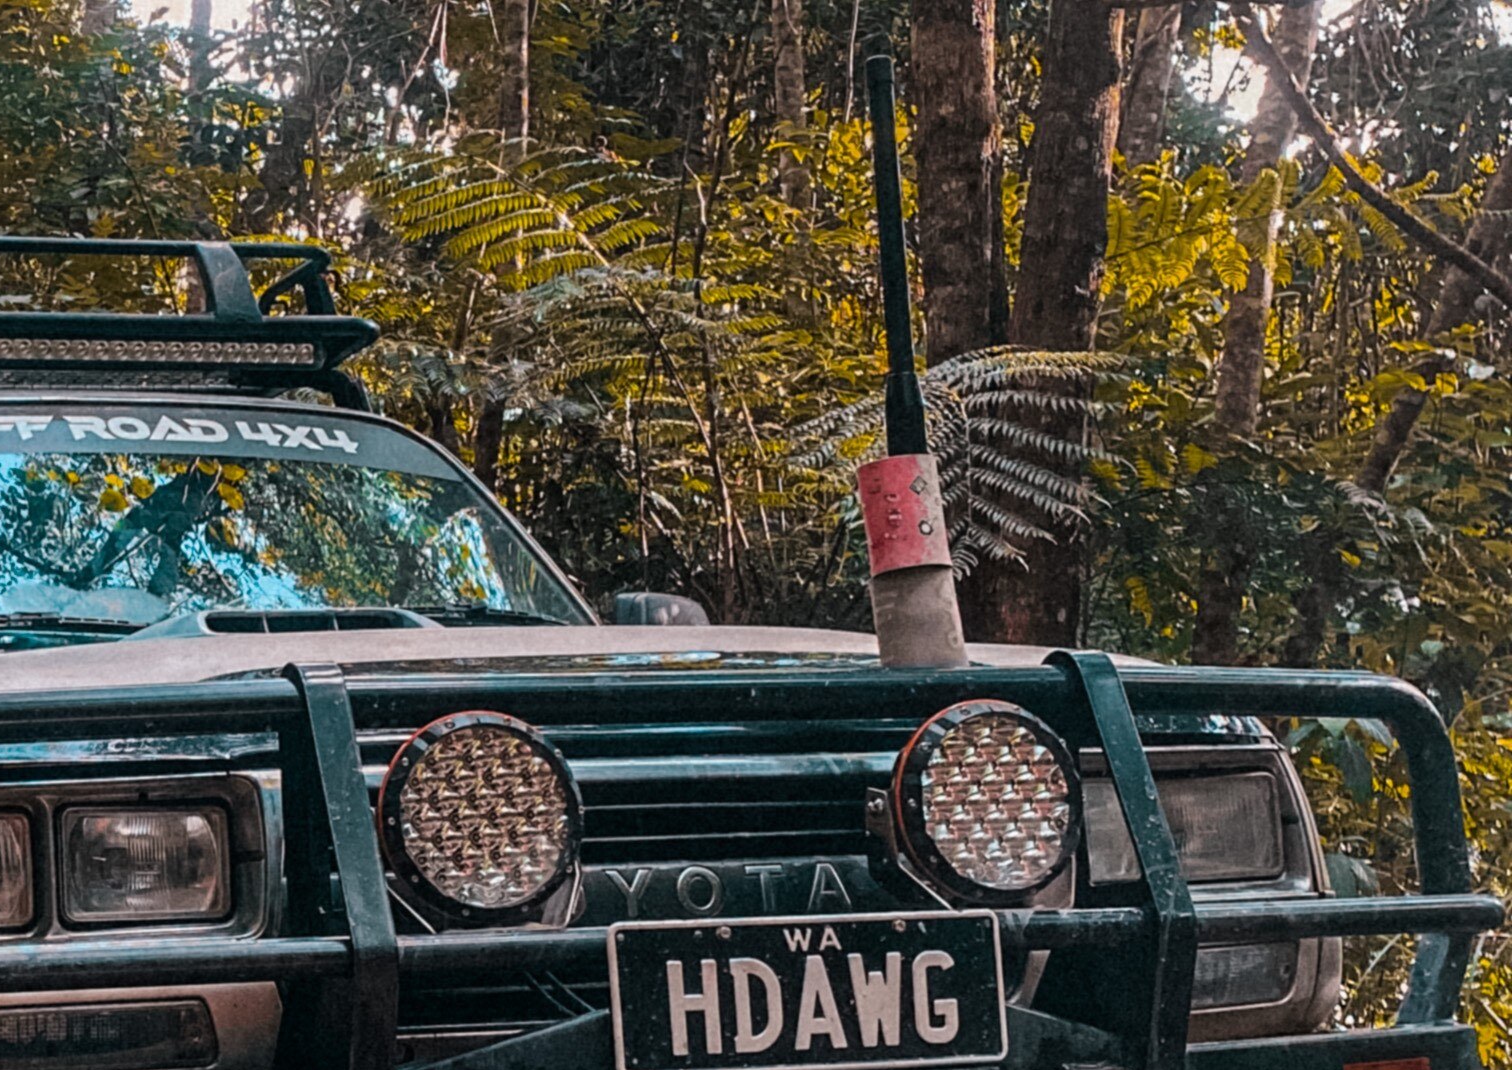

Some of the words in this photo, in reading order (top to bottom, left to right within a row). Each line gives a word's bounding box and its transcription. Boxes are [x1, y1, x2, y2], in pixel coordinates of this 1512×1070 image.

[62, 415, 229, 442] ROAD
[237, 423, 359, 454] 4X4
[574, 862, 852, 916] YOTA
[782, 926, 841, 952] WA
[666, 950, 959, 1057] HDAWG
